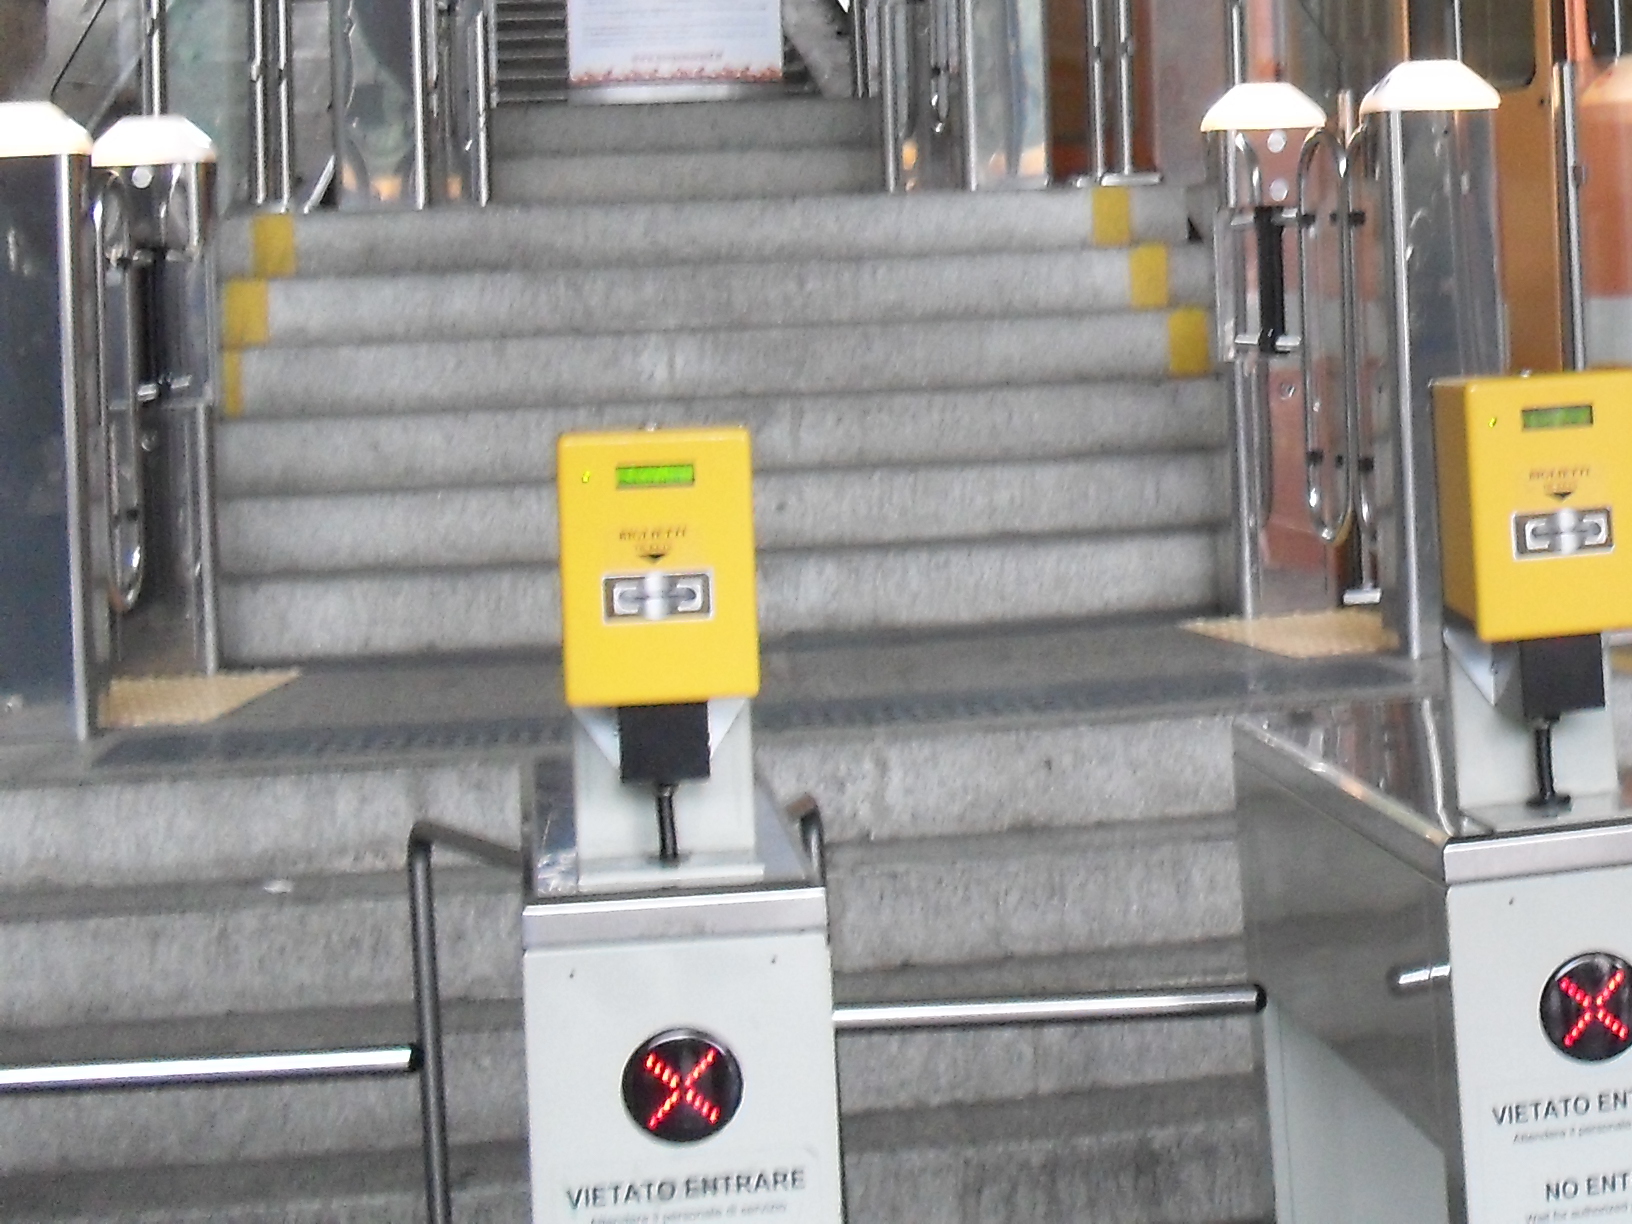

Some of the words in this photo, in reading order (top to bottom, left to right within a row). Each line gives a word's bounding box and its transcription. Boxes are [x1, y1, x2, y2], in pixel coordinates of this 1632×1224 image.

[1492, 1095, 1591, 1126] VIETATO
[566, 1180, 677, 1210] VIETATO
[684, 1167, 806, 1199] ENTRARE
[1545, 1178, 1579, 1203] NO
